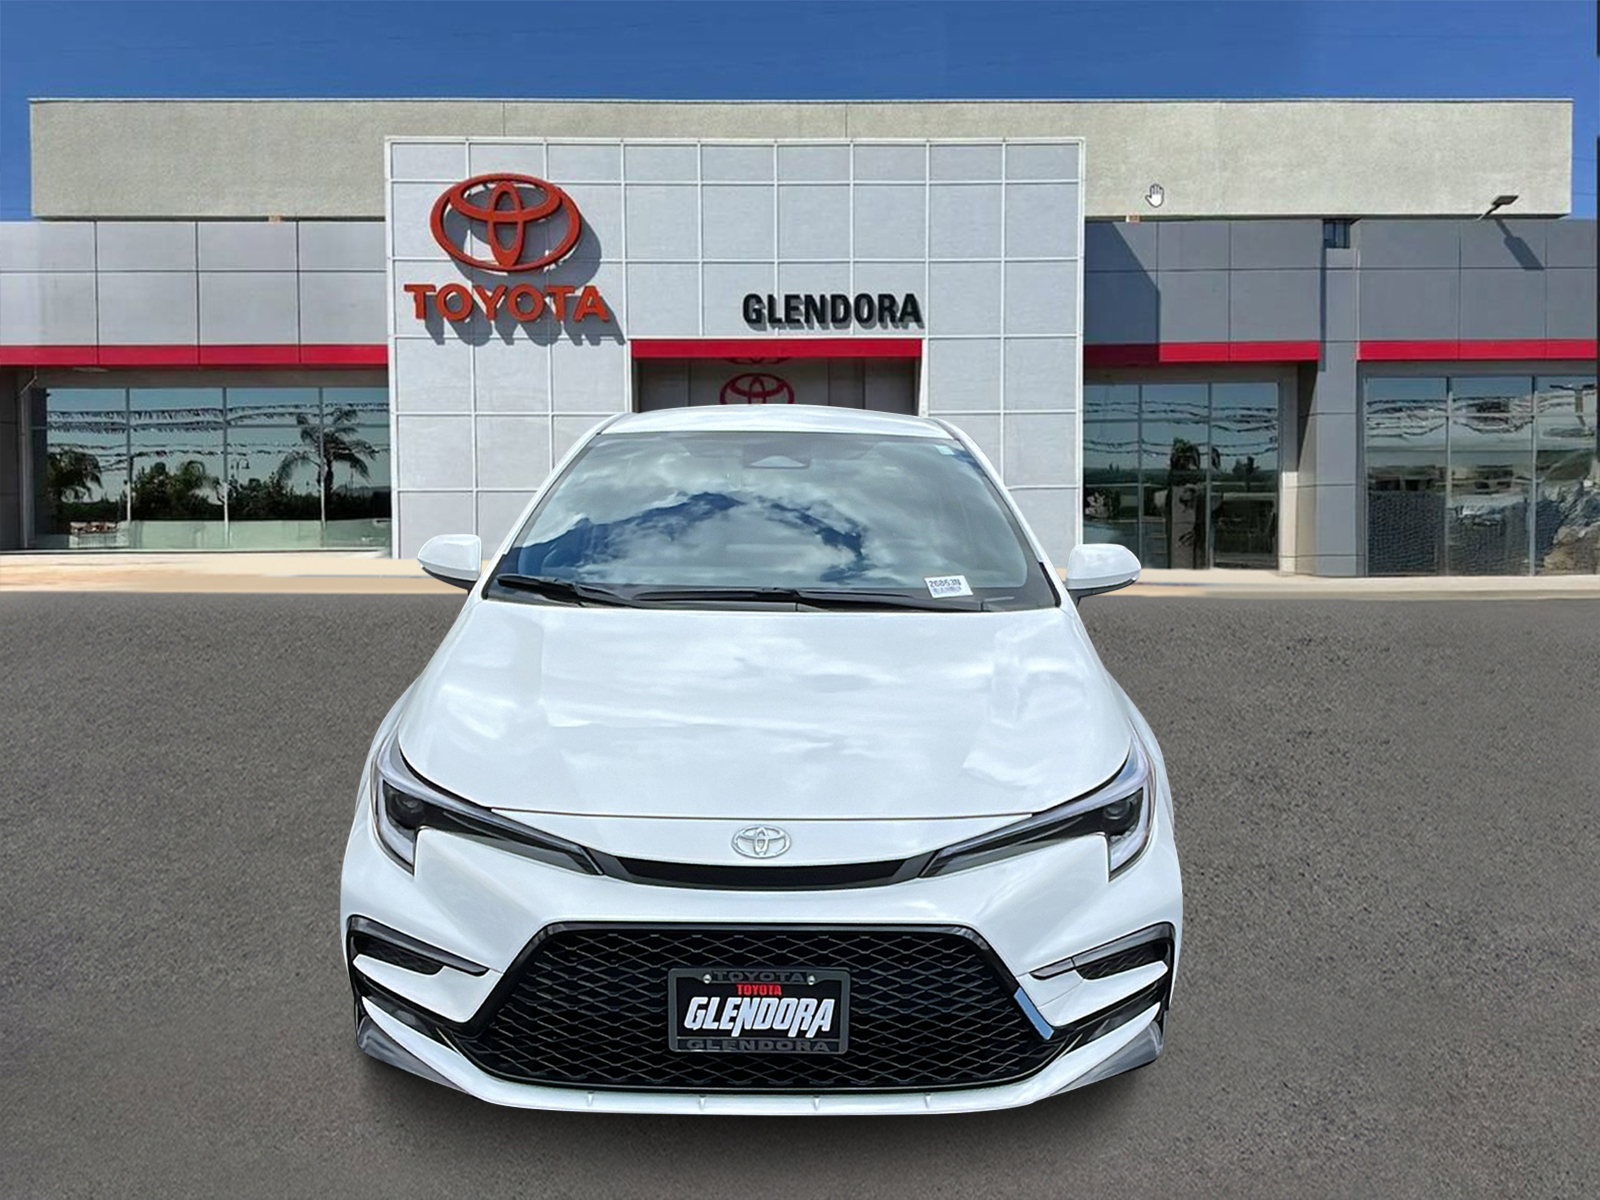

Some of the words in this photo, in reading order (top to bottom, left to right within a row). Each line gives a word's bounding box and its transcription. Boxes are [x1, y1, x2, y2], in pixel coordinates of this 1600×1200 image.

[404, 283, 610, 323] TOYOTA
[743, 293, 922, 325] GLENDORA
[713, 971, 806, 983] TOYOTA
[736, 984, 783, 996] TOYOTA
[684, 997, 835, 1038] GLENDORA
[686, 1039, 830, 1052] GLENDORA
